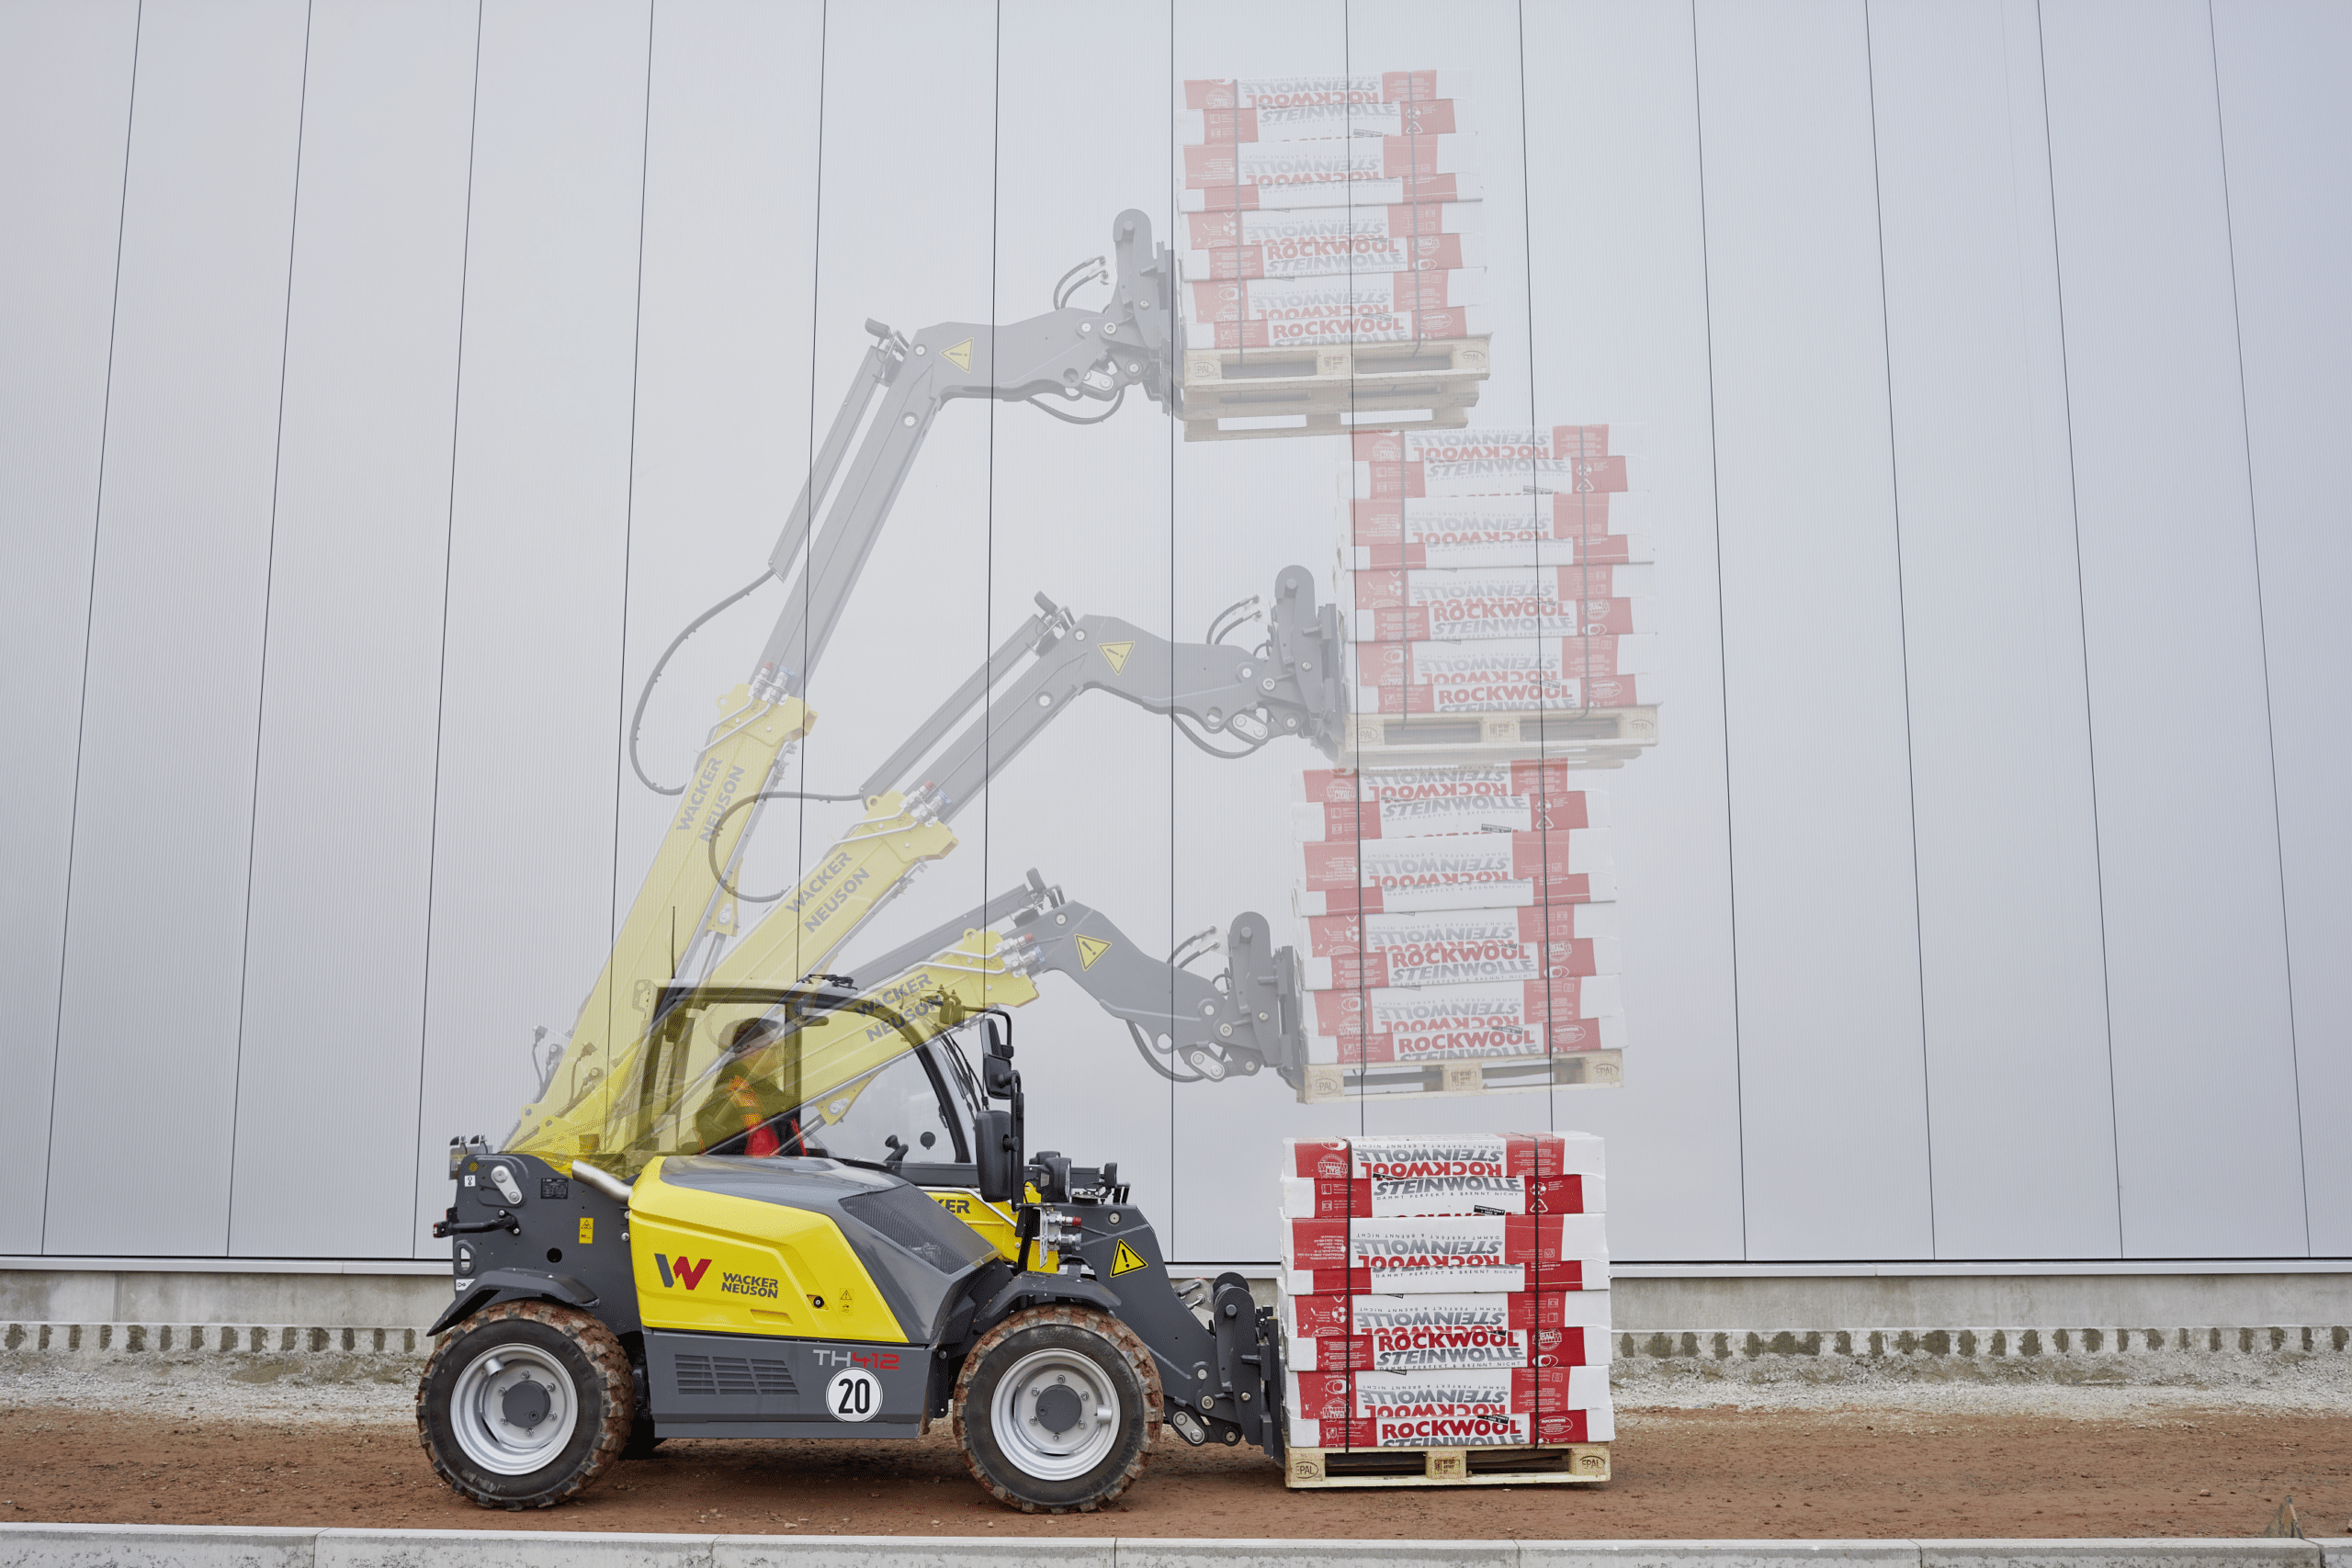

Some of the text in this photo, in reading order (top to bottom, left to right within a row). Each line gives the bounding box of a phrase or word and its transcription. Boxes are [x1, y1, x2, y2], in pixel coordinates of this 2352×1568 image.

[1238, 80, 1378, 93] STEINWOLLE
[1247, 91, 1377, 107] ROCKWOOL
[1260, 103, 1399, 122] STEINWOLLE
[1238, 159, 1380, 175] STEINWOLLE
[1243, 222, 1386, 239] STEINWOLLE
[1267, 239, 1399, 260] ROCKWOOL
[1266, 254, 1408, 273] STEINWOLLE
[1248, 292, 1391, 308] STEINWOLLE
[1273, 319, 1404, 339] ROCKWOOL
[1405, 434, 1550, 446] STEINWOLLE
[1414, 446, 1548, 460] ROCKWOOL
[1427, 457, 1570, 477] STEINWOLLE
[1405, 516, 1551, 533] STEINWOLLE
[1414, 531, 1548, 544] ROCKWOOL
[1409, 584, 1555, 600] STEINWOLLE
[1433, 602, 1568, 622] ROCKWOOL
[1432, 617, 1577, 636] STEINWOLLE
[1413, 658, 1560, 672] STEINWOLLE
[1422, 671, 1556, 685] ROCKWOOL
[1439, 685, 1572, 705] ROCKWOOL
[1360, 770, 1508, 784] STEINWOLLE
[676, 757, 723, 829] WACKER
[1369, 782, 1507, 800] ROCKWOOL
[699, 765, 745, 842] NEUSON
[1383, 795, 1530, 817] STEINWOLLE
[1361, 857, 1510, 876] STEINWOLLE
[786, 852, 853, 912] WACKER
[1370, 872, 1508, 887] ROCKWOOL
[804, 867, 870, 932] NEUSON
[1366, 926, 1516, 945] STEINWOLLE
[1391, 945, 1530, 968] ROCKWOOL
[1391, 960, 1538, 982] STEINWOLLE
[854, 974, 933, 1018] WACKER
[865, 995, 944, 1042] NEUSON
[1372, 1002, 1521, 1020] STEINWOLLE
[1381, 1016, 1519, 1033] ROCKWOOL
[1399, 1031, 1535, 1054] ROCKWOOL
[1351, 1148, 1503, 1162] STEINWOLLE
[1361, 1162, 1501, 1178] ROCKWOOL
[1374, 1176, 1524, 1195] STEINWOLLE
[1350, 1238, 1502, 1256] STEINWOLLE
[1359, 1255, 1499, 1268] ROCKWOOL
[722, 1271, 778, 1289] WACKER
[721, 1282, 778, 1298] NEUSON
[1353, 1312, 1506, 1327] STEINWOLLE
[1378, 1331, 1519, 1351] ROCKWOOL
[813, 1349, 899, 1371] TH412
[1376, 1348, 1527, 1366] STEINWOLLE
[838, 1378, 870, 1414] 20
[1356, 1390, 1509, 1404] STEINWOLLE
[1365, 1404, 1505, 1418] ROCKWOOL
[1383, 1420, 1521, 1439] ROCKWOOL
